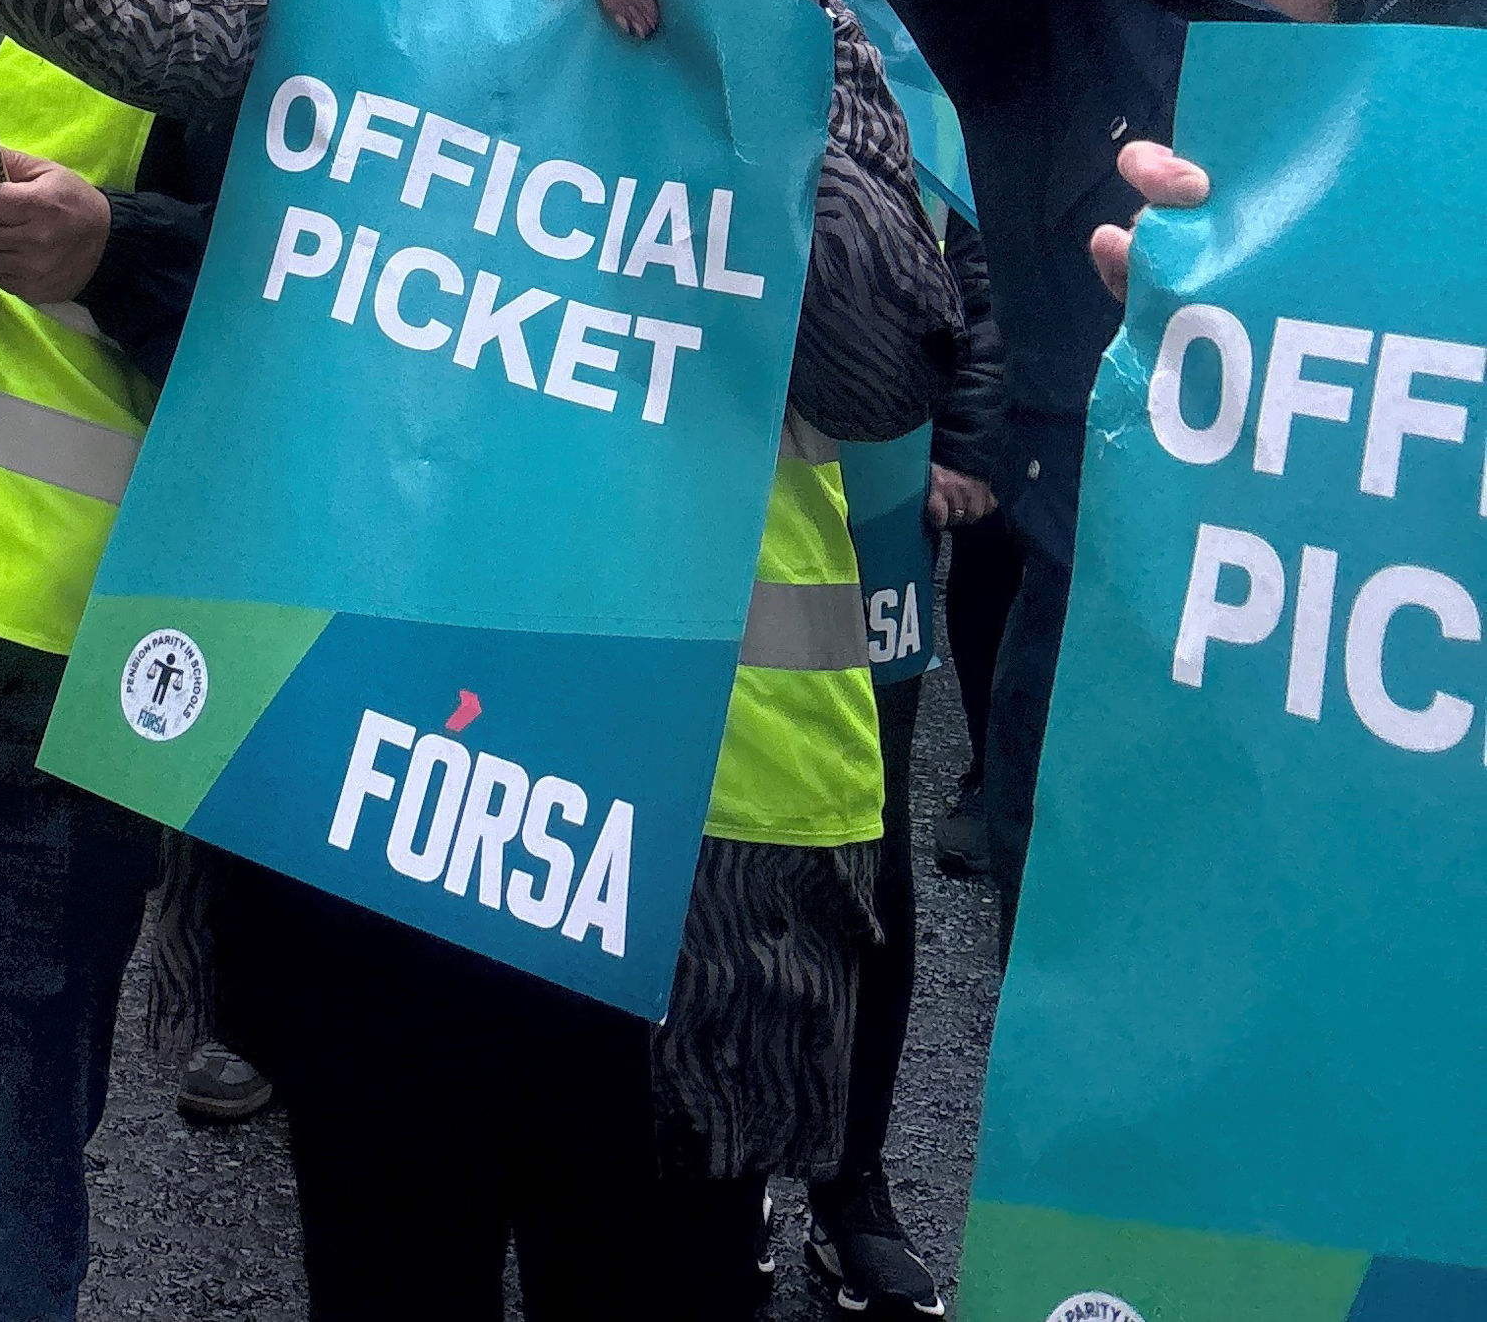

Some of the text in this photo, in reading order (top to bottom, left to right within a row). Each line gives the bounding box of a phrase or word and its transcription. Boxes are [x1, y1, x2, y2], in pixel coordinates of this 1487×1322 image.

[264, 75, 766, 299] OFFICIAL
[262, 205, 702, 425] PICKET
[1148, 303, 1487, 516] OFF
[126, 635, 203, 719] PENSION PARITY IN SCHOOLS
[865, 582, 921, 663] SA
[1172, 523, 1487, 764] PIC
[328, 688, 635, 958] FÓRSA
